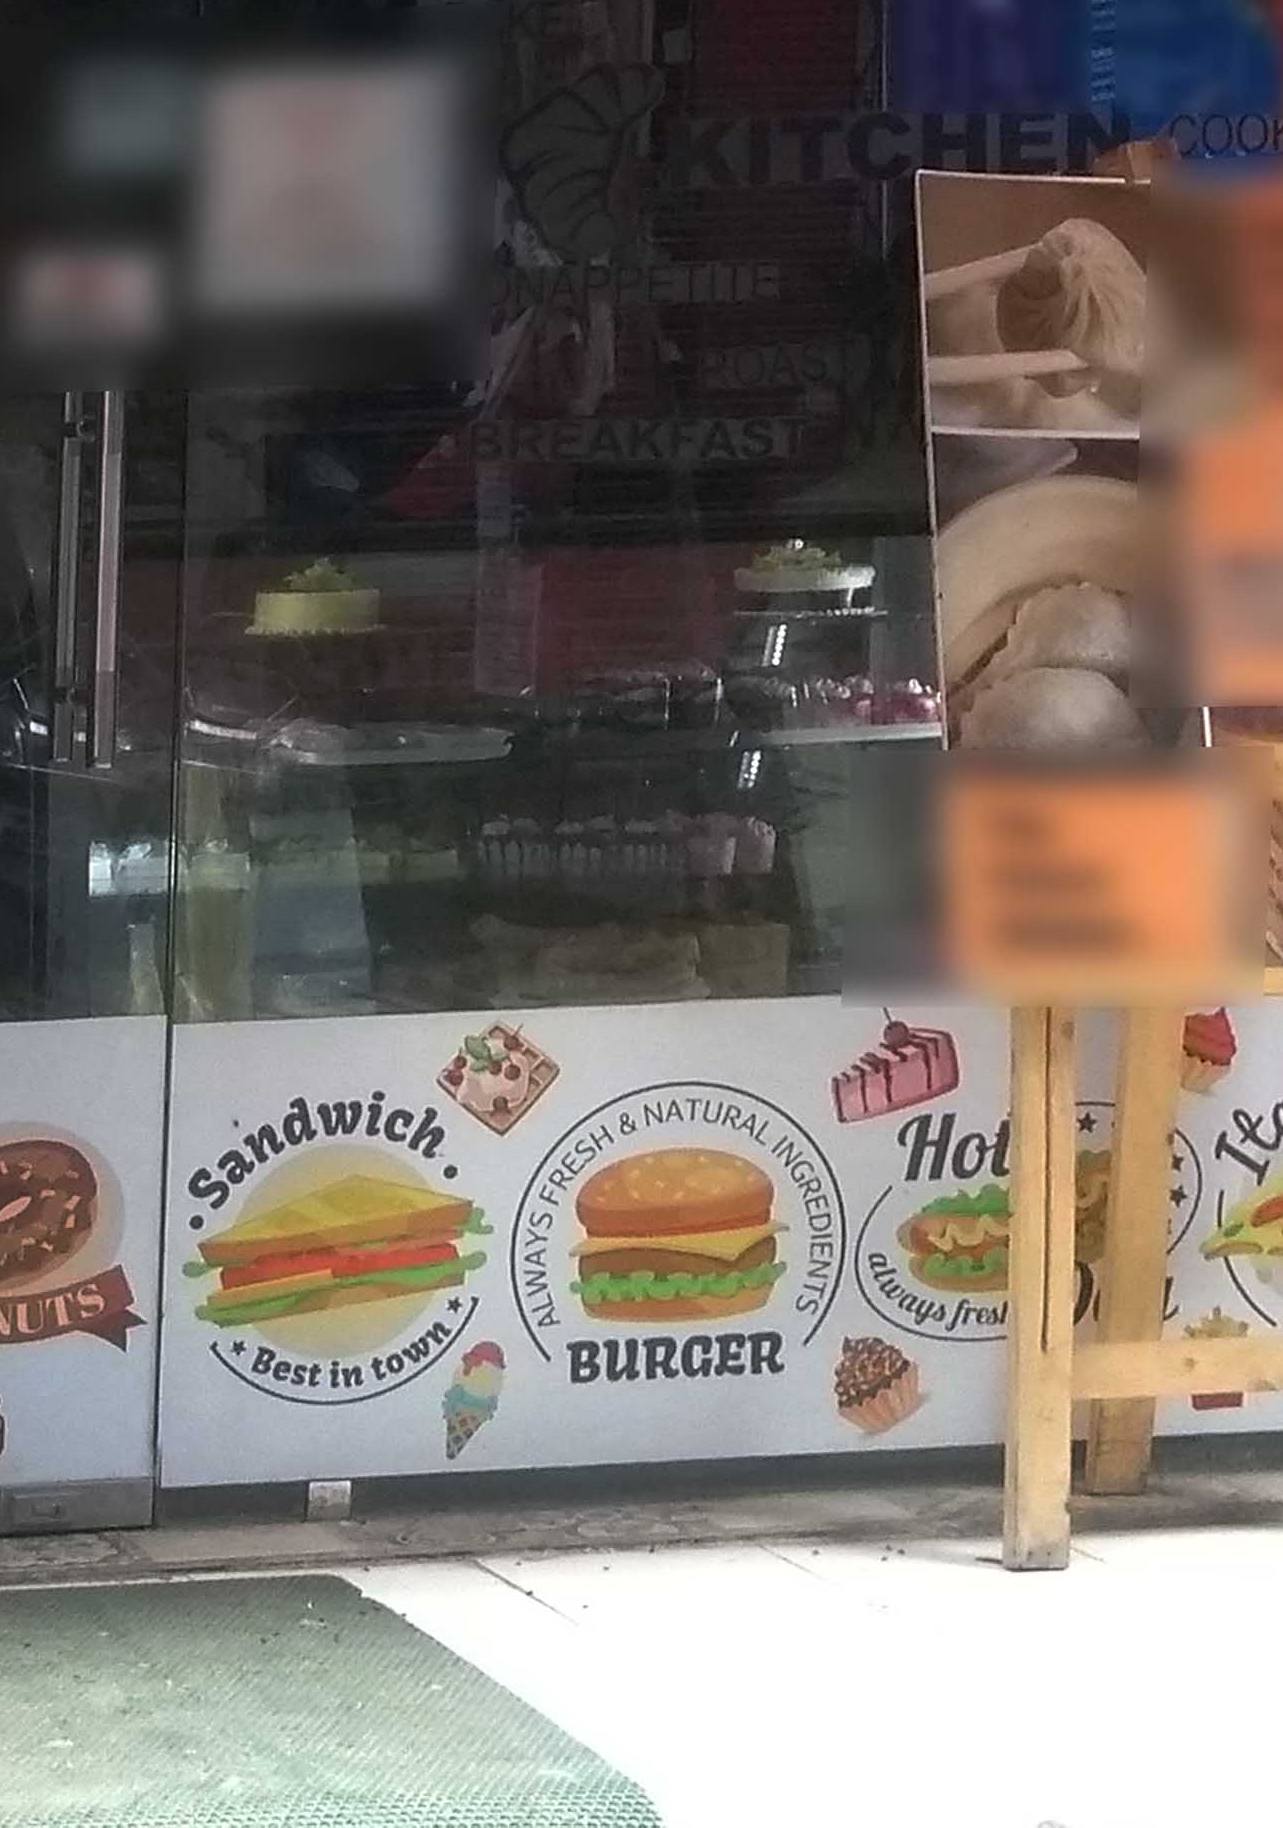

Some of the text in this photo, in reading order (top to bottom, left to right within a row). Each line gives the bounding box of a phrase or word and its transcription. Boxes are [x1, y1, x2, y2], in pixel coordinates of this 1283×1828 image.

[674, 111, 1132, 180] KITCHEN
[473, 418, 806, 460] BREAKFAST
[188, 1090, 445, 1211] Sandwich
[523, 1097, 835, 1329] ALWAYS FRESH & NATURAL INGREDIENTS
[868, 1251, 946, 1326] always
[250, 1319, 454, 1390] Best in town
[567, 1330, 786, 1386] BURGER
